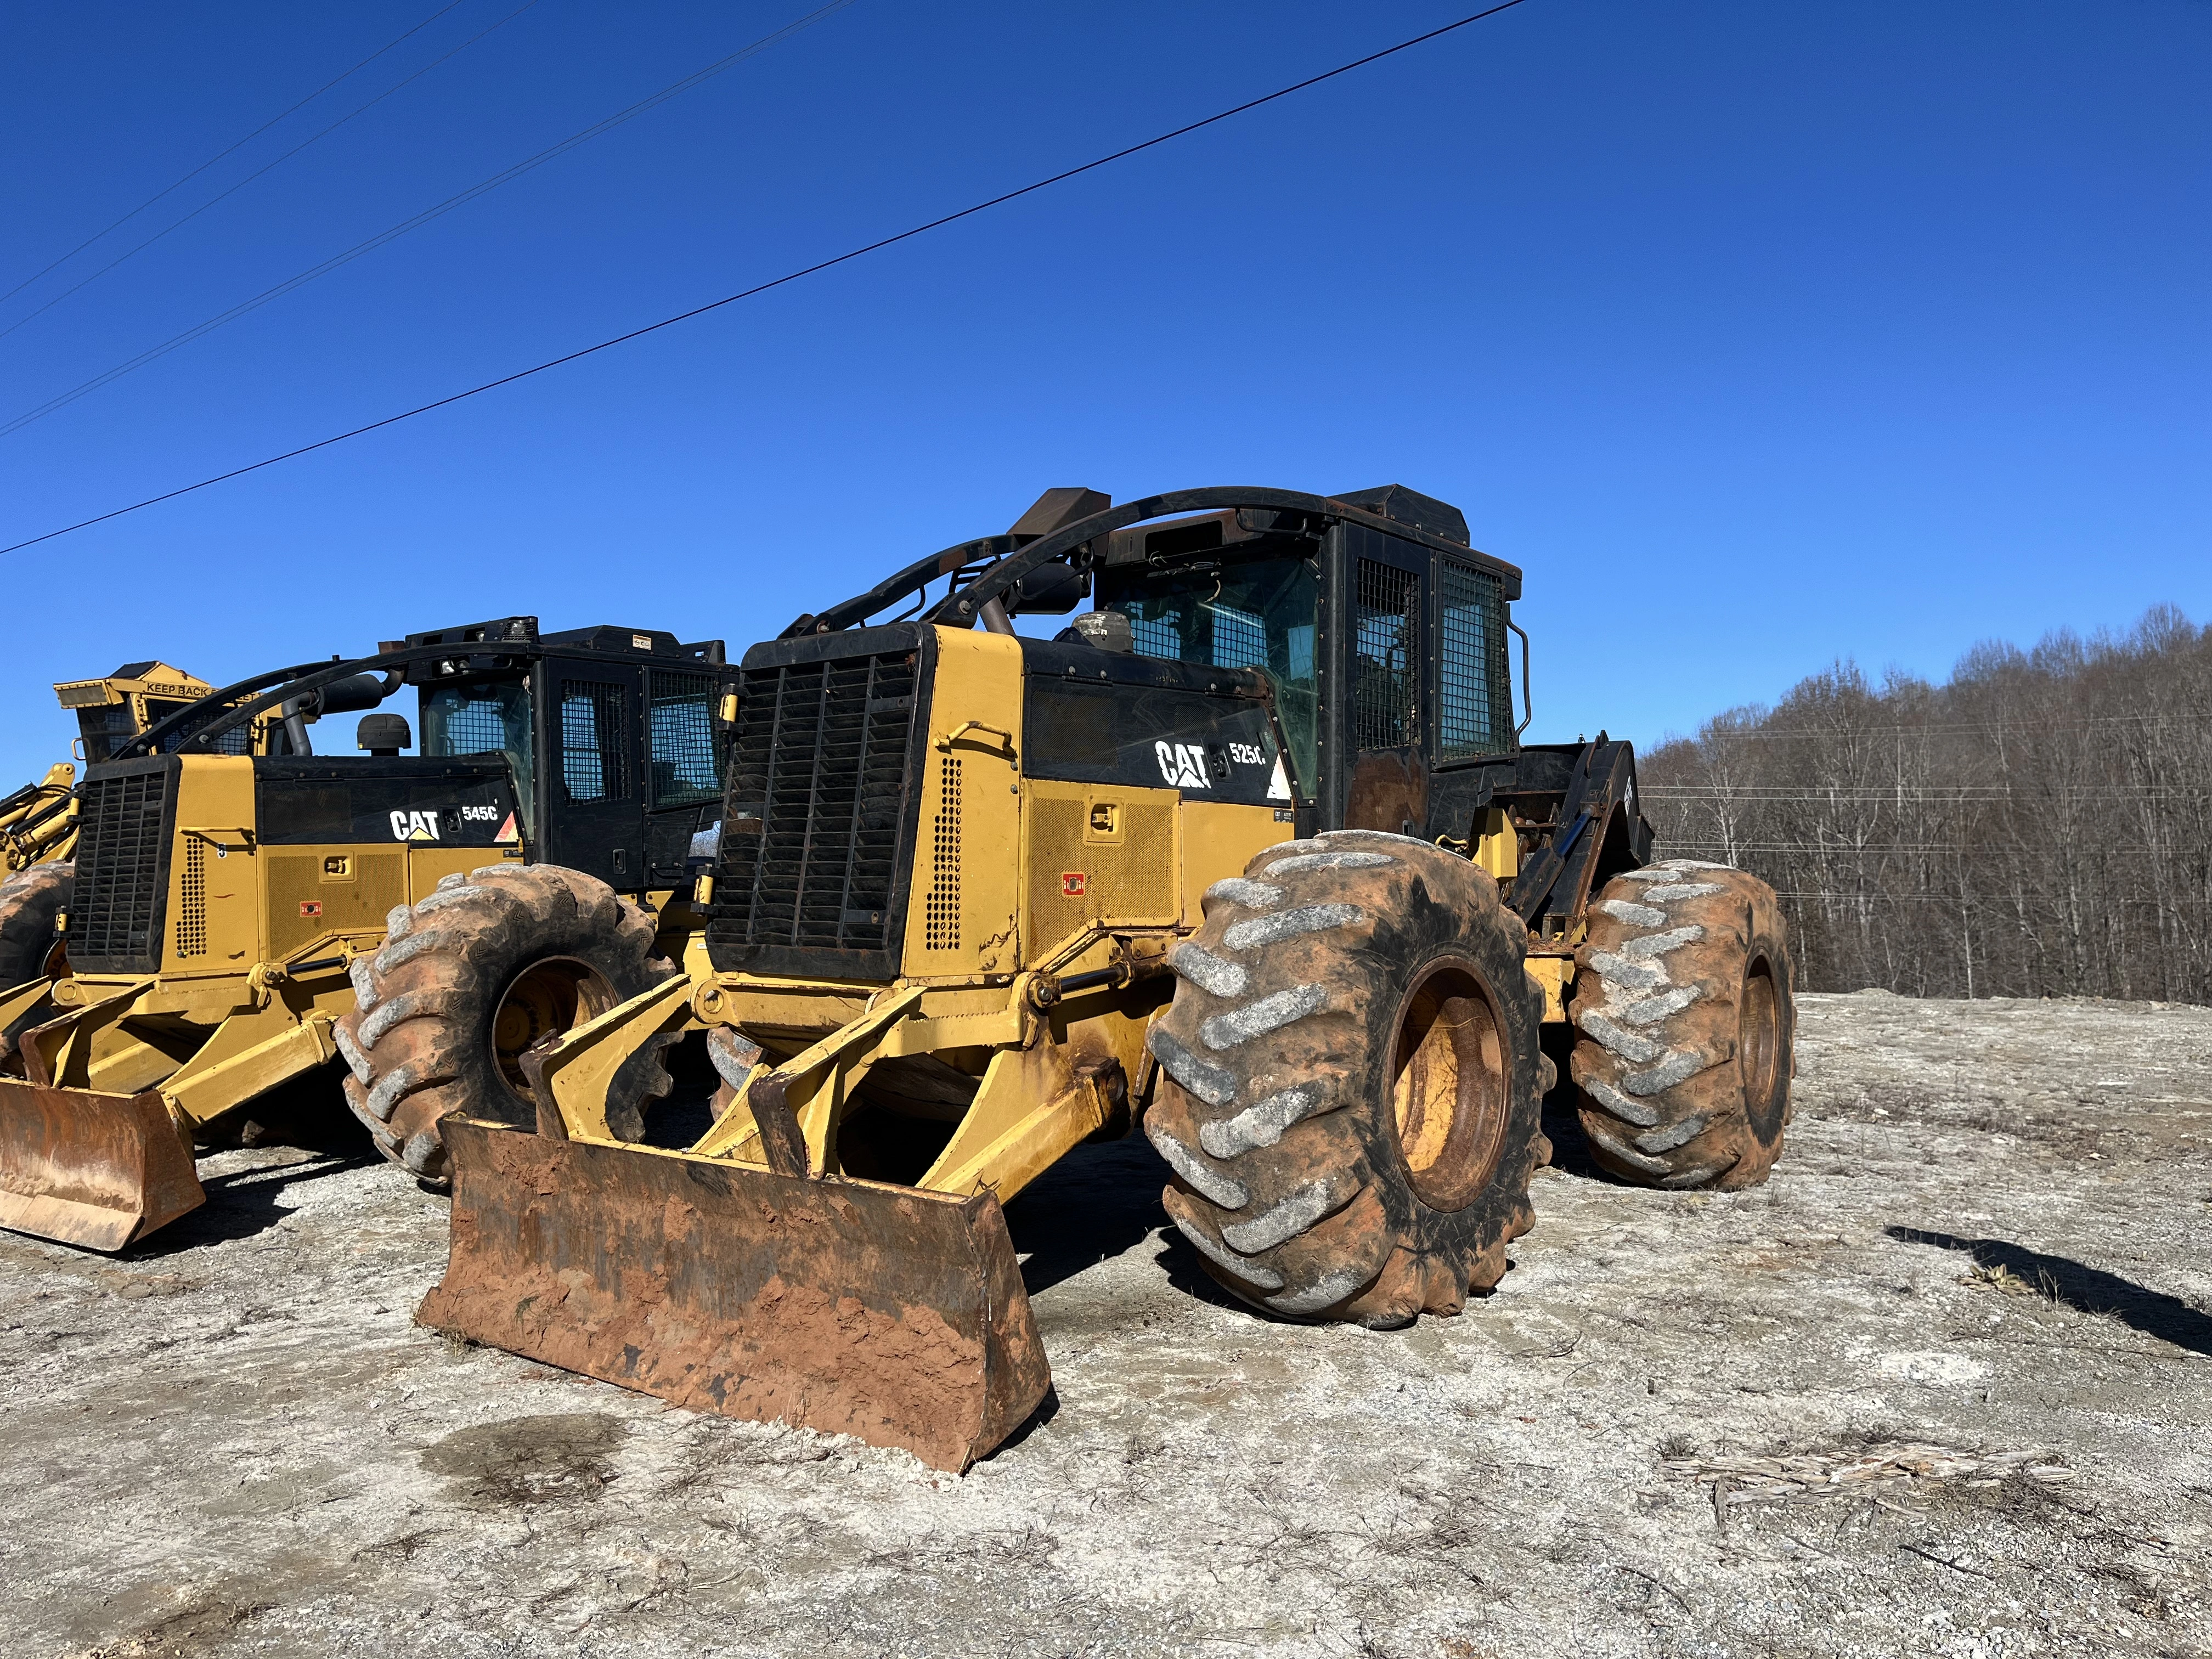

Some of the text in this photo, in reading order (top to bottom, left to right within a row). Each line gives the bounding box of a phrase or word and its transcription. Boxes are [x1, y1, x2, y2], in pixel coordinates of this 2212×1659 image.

[147, 682, 175, 693] KEEP
[178, 685, 207, 696] BACK
[1155, 741, 1266, 788] CAT 525C
[390, 806, 498, 840] CAT 545C
